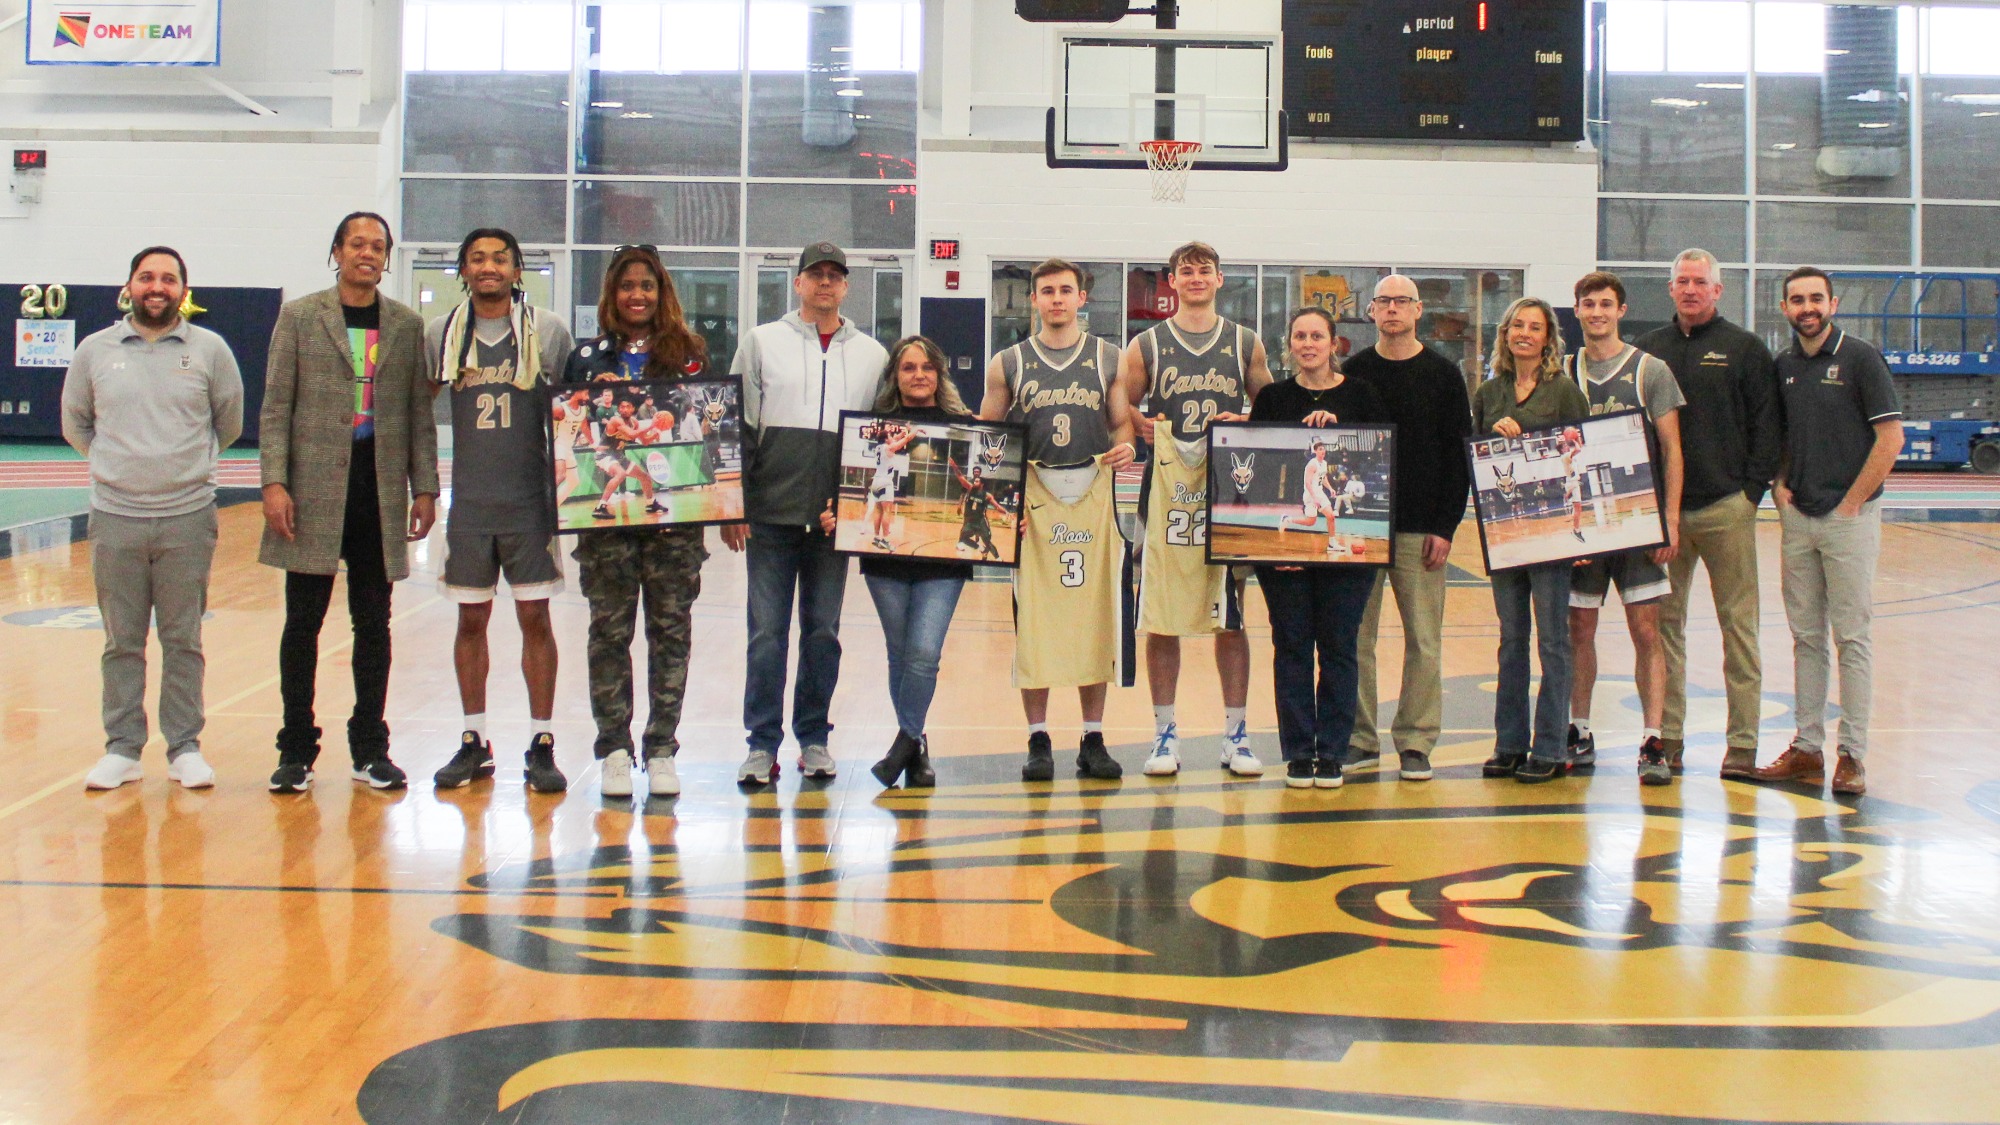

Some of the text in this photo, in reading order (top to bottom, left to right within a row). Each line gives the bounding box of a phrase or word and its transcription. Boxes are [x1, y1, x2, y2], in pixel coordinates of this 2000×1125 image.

[93, 24, 192, 39] ONETEAM
[1416, 17, 1454, 32] period
[1305, 45, 1333, 59] fouls
[1416, 47, 1453, 62] player
[1535, 51, 1562, 64] fouls
[1308, 112, 1330, 123] won
[1419, 114, 1449, 127] game
[1537, 117, 1560, 127] won
[934, 242, 957, 258] EXIT
[20, 284, 67, 318] 20
[1157, 295, 1175, 312] 21
[1906, 353, 1960, 365] GS-3246
[1159, 366, 1238, 399] Canton
[1020, 379, 1100, 414] Canton
[476, 392, 511, 429] 21
[1182, 399, 1218, 433] 22
[1052, 413, 1071, 447] 3
[1050, 522, 1093, 545] Roos
[1166, 508, 1206, 546] 22
[1059, 550, 1084, 588] 3
